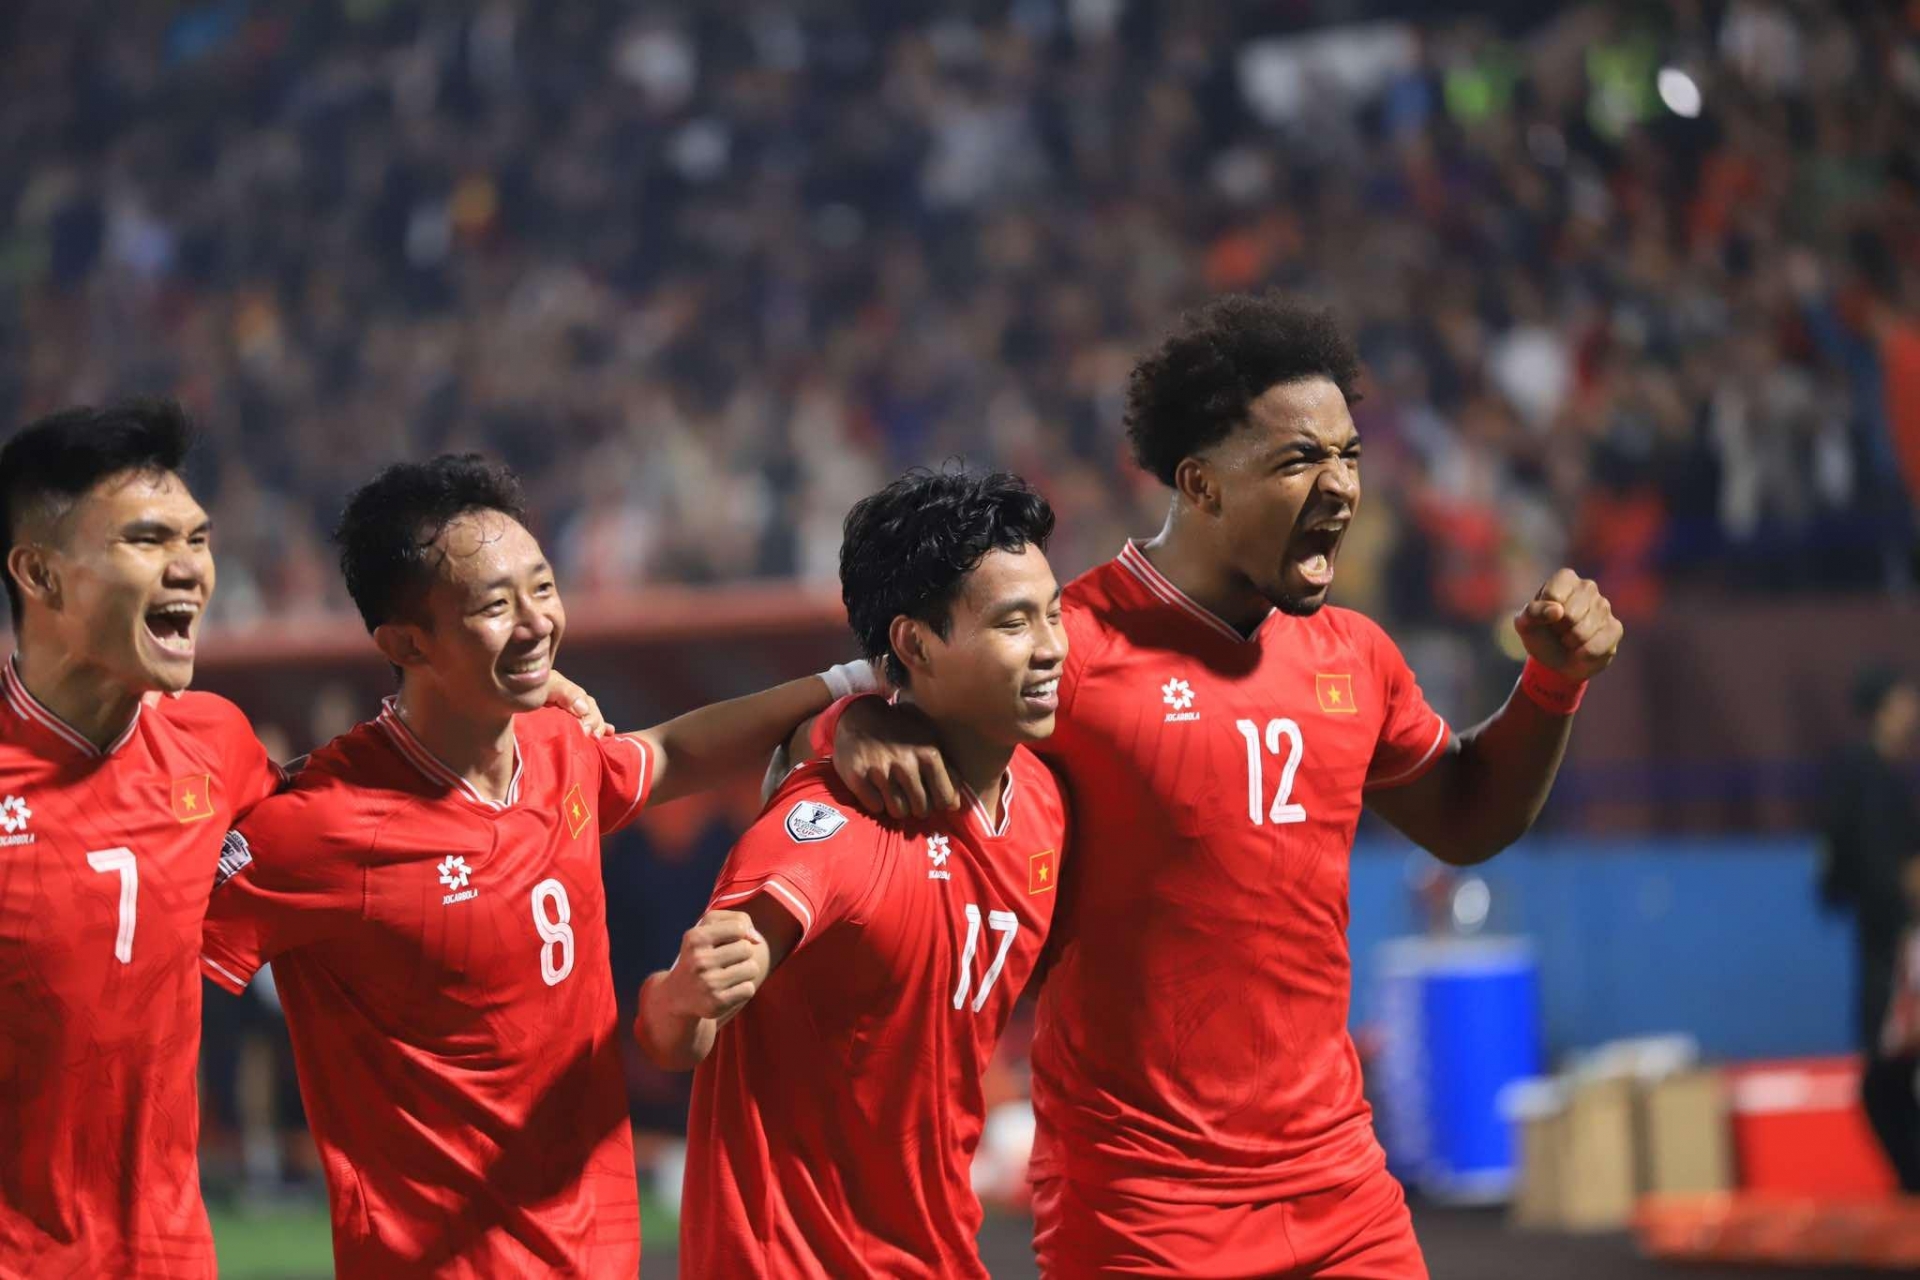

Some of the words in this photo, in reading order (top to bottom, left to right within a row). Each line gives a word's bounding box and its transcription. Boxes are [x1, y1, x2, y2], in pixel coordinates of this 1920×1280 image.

[1236, 717, 1307, 826] 12
[86, 846, 138, 964] 7
[531, 878, 575, 987] 8
[953, 903, 1019, 1014] 17
